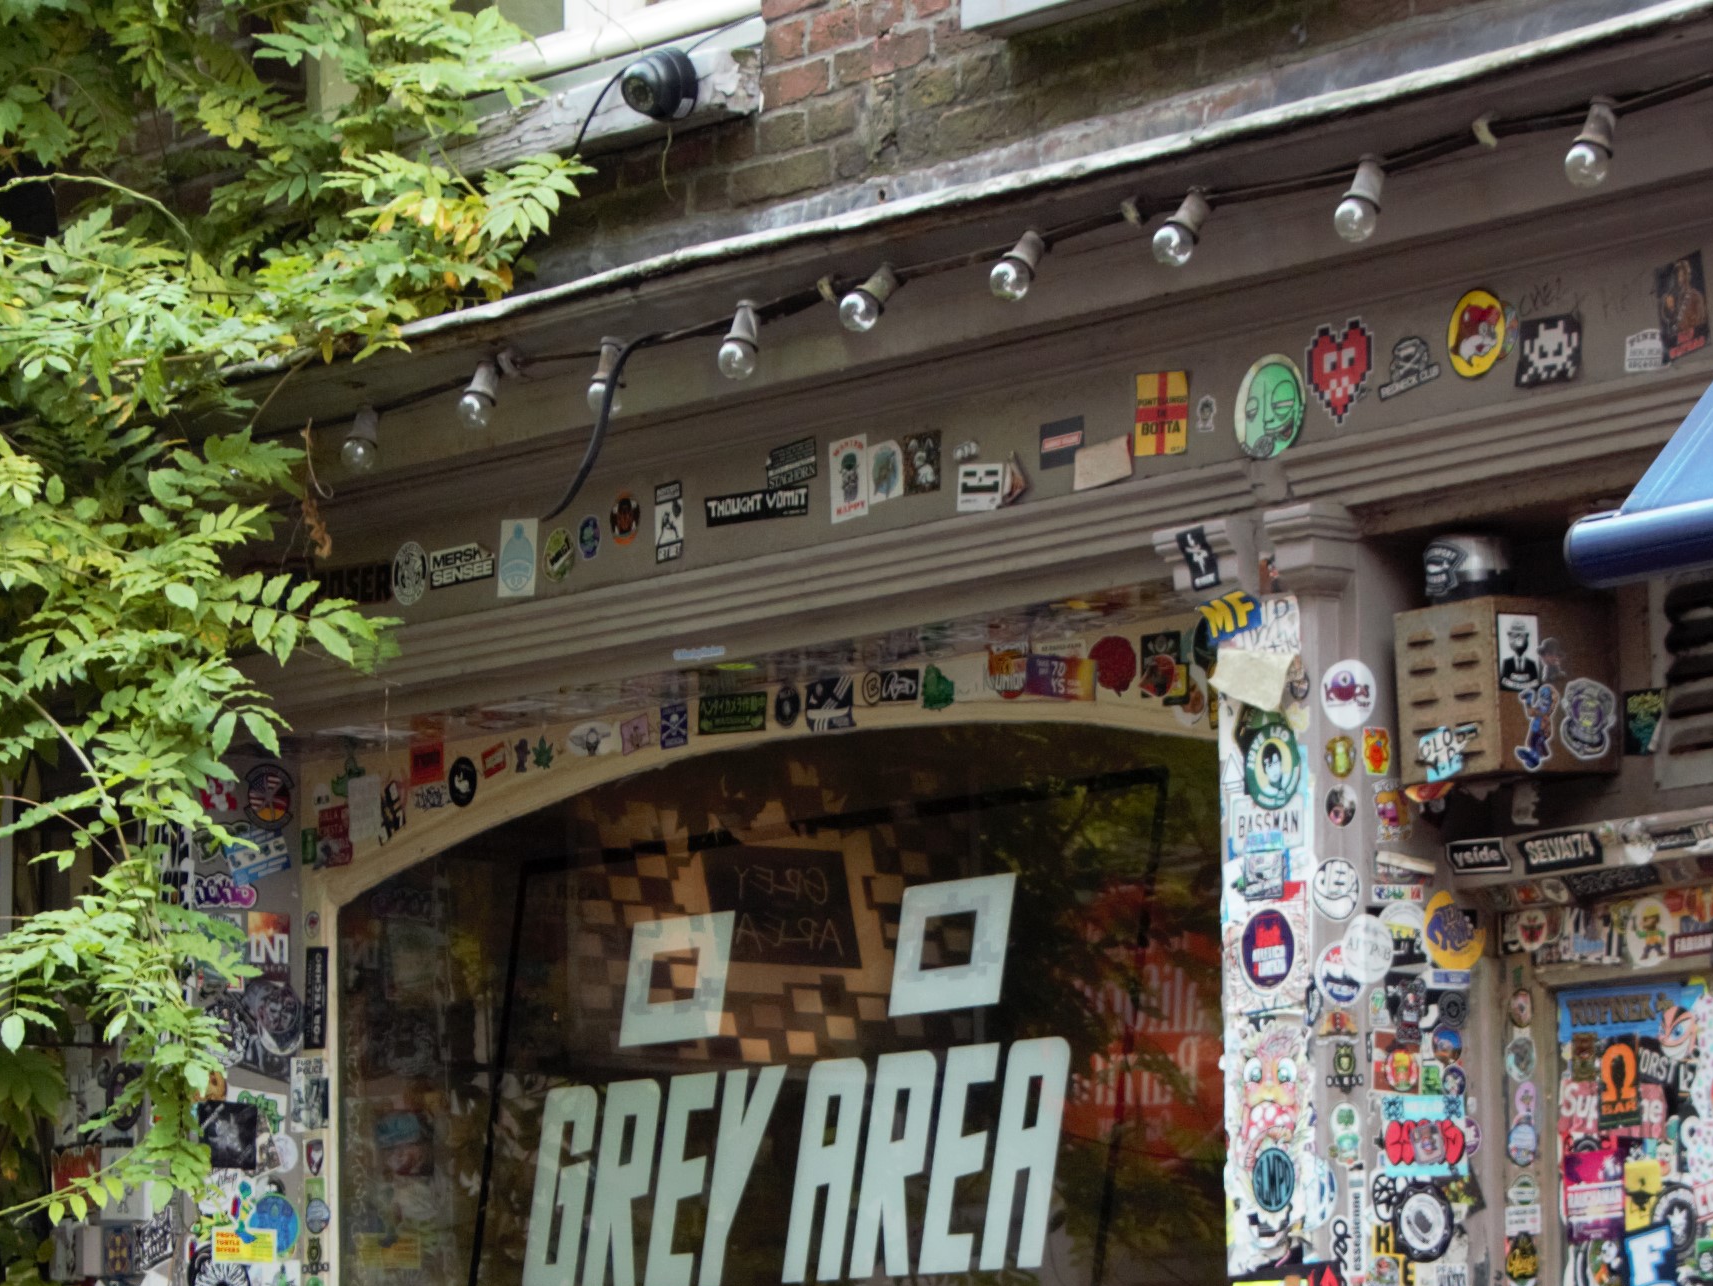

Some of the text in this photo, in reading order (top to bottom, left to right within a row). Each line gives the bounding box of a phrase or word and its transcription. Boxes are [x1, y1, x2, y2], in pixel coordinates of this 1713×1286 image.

[1140, 420, 1181, 437] BOTTA
[707, 487, 807, 518] THOUGHT VOMIT
[1199, 591, 1255, 638] MF
[780, 1035, 1072, 1285] AREA
